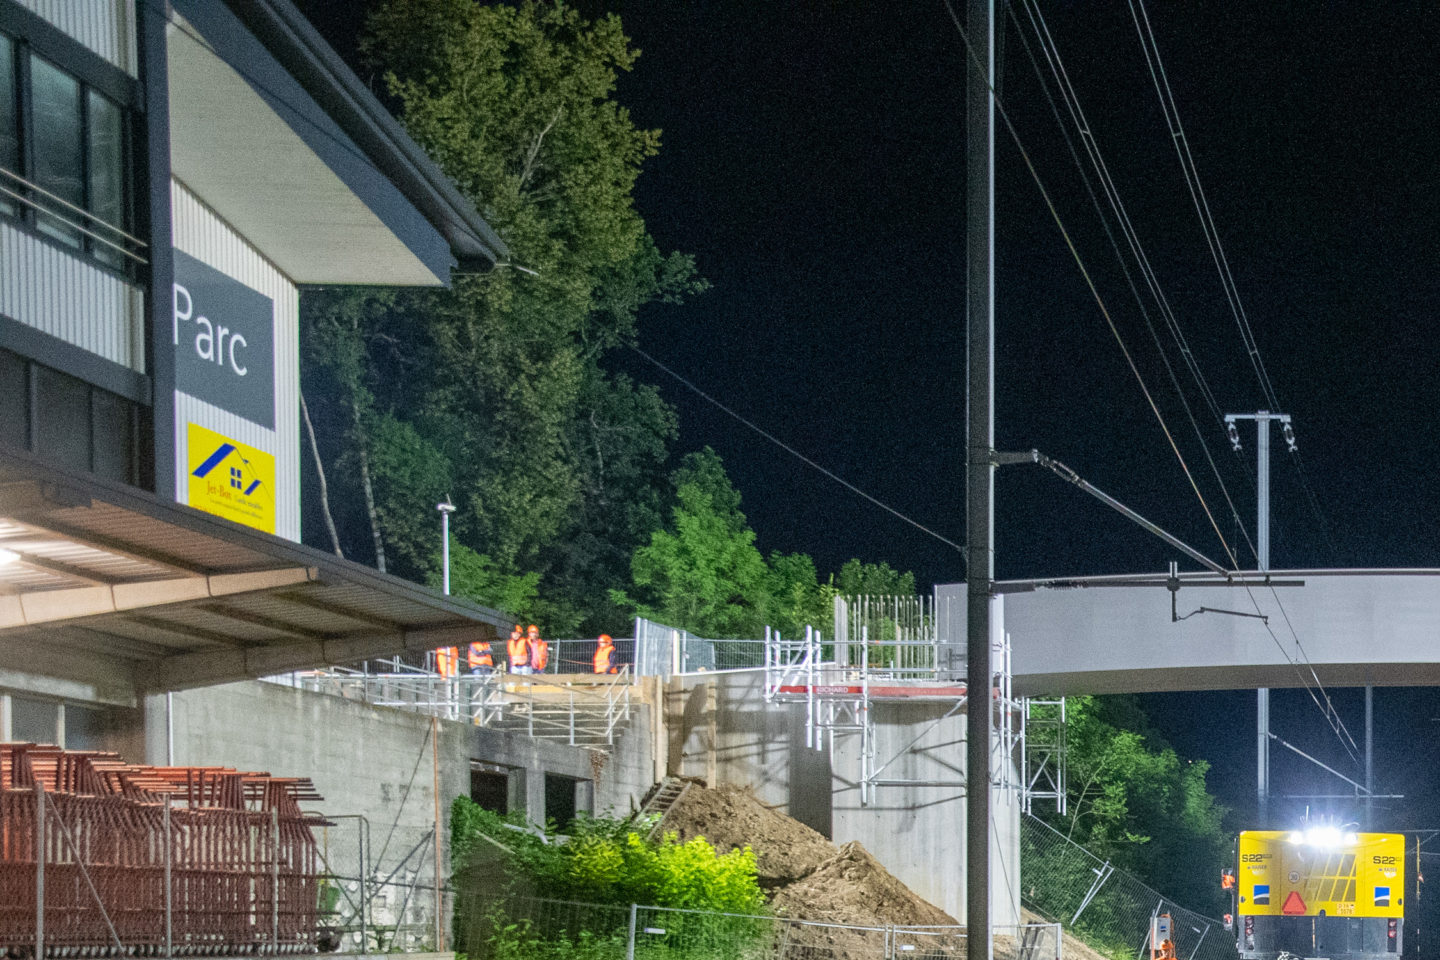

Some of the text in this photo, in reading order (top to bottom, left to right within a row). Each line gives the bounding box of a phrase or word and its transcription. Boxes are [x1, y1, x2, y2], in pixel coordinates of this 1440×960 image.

[172, 282, 248, 377] Parc
[1242, 854, 1263, 863] S22
[1373, 856, 1396, 865] S22
